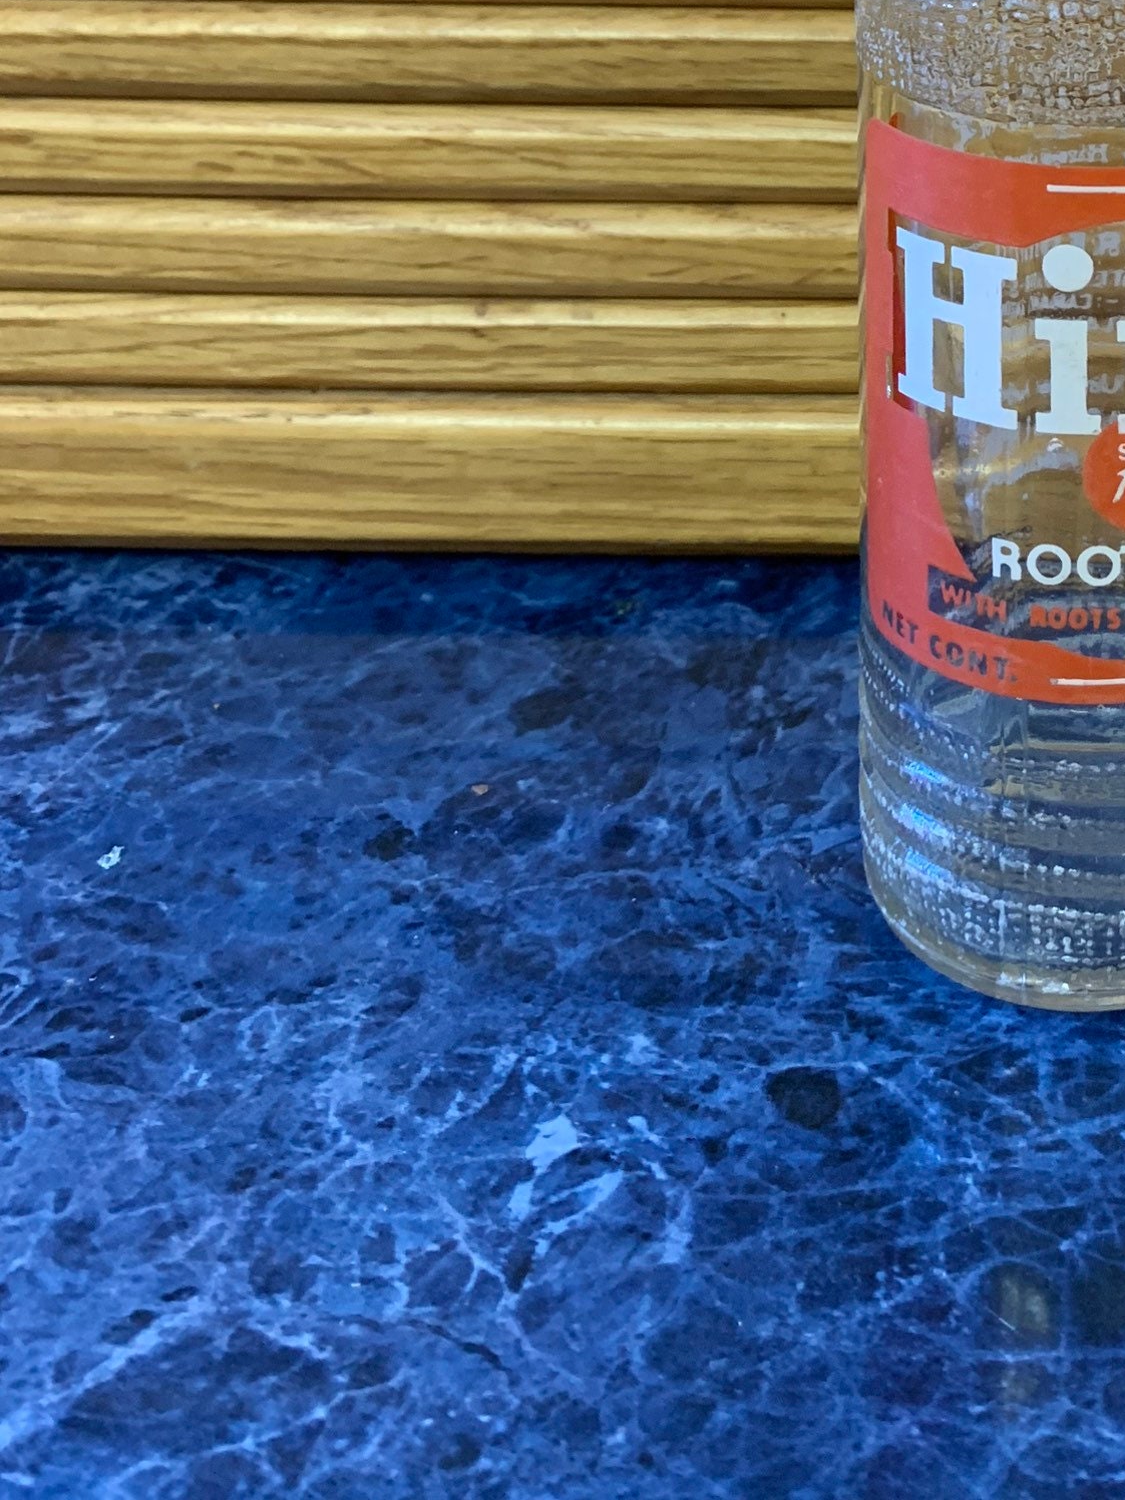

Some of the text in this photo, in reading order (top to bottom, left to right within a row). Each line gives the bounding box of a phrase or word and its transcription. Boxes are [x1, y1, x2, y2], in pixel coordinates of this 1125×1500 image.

[940, 579, 1008, 624] WITH
[881, 599, 918, 645] NET
[929, 634, 1018, 683] CONT.
